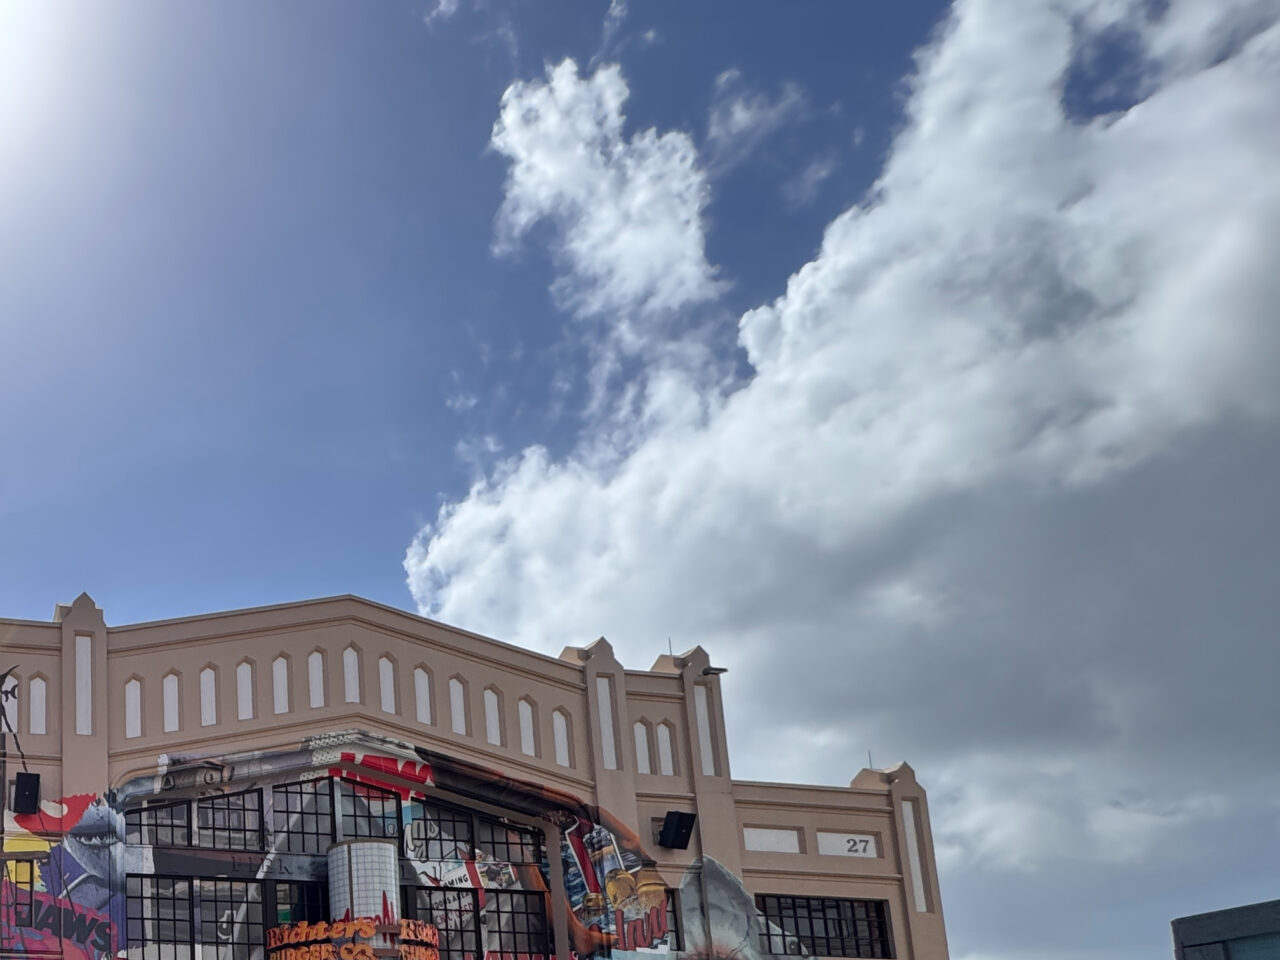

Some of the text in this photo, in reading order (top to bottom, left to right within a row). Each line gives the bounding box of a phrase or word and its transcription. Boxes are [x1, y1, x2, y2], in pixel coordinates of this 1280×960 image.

[846, 838, 870, 854] 27
[15, 899, 112, 952] JAWS
[266, 917, 377, 950] Richter's
